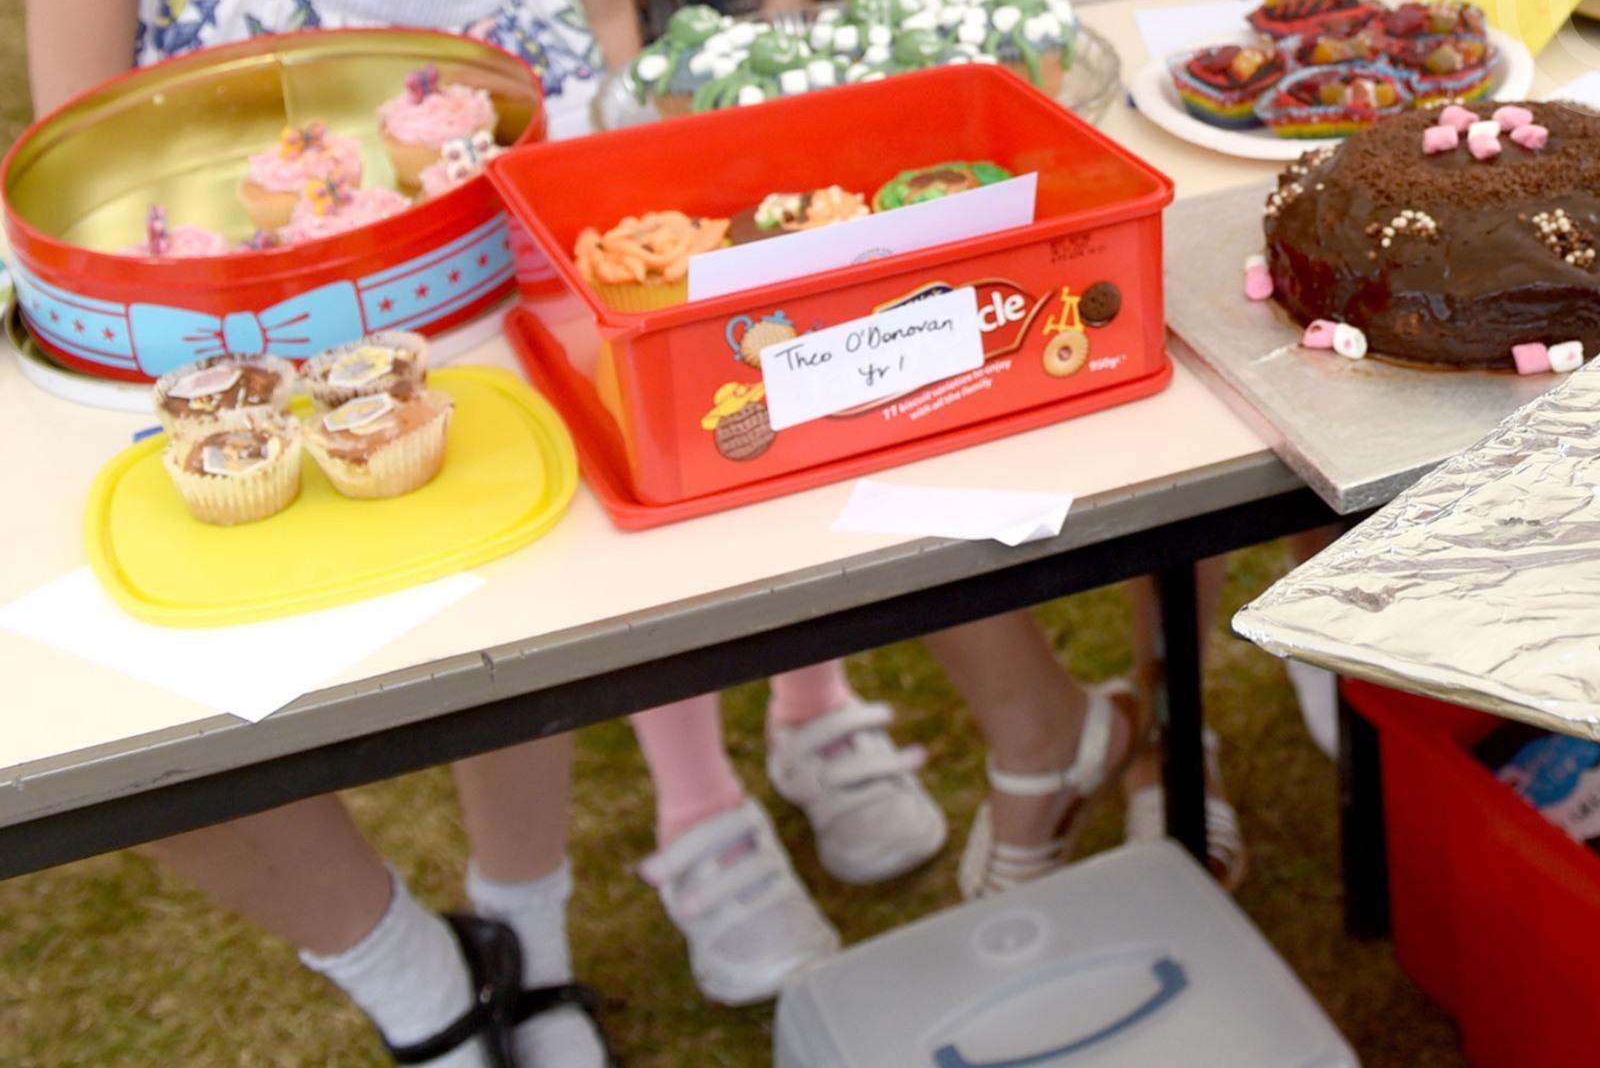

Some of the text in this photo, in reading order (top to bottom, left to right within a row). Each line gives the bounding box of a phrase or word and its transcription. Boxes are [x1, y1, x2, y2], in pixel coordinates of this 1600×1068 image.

[979, 291, 1026, 332] cle
[773, 318, 953, 371] Theo O'Donovan
